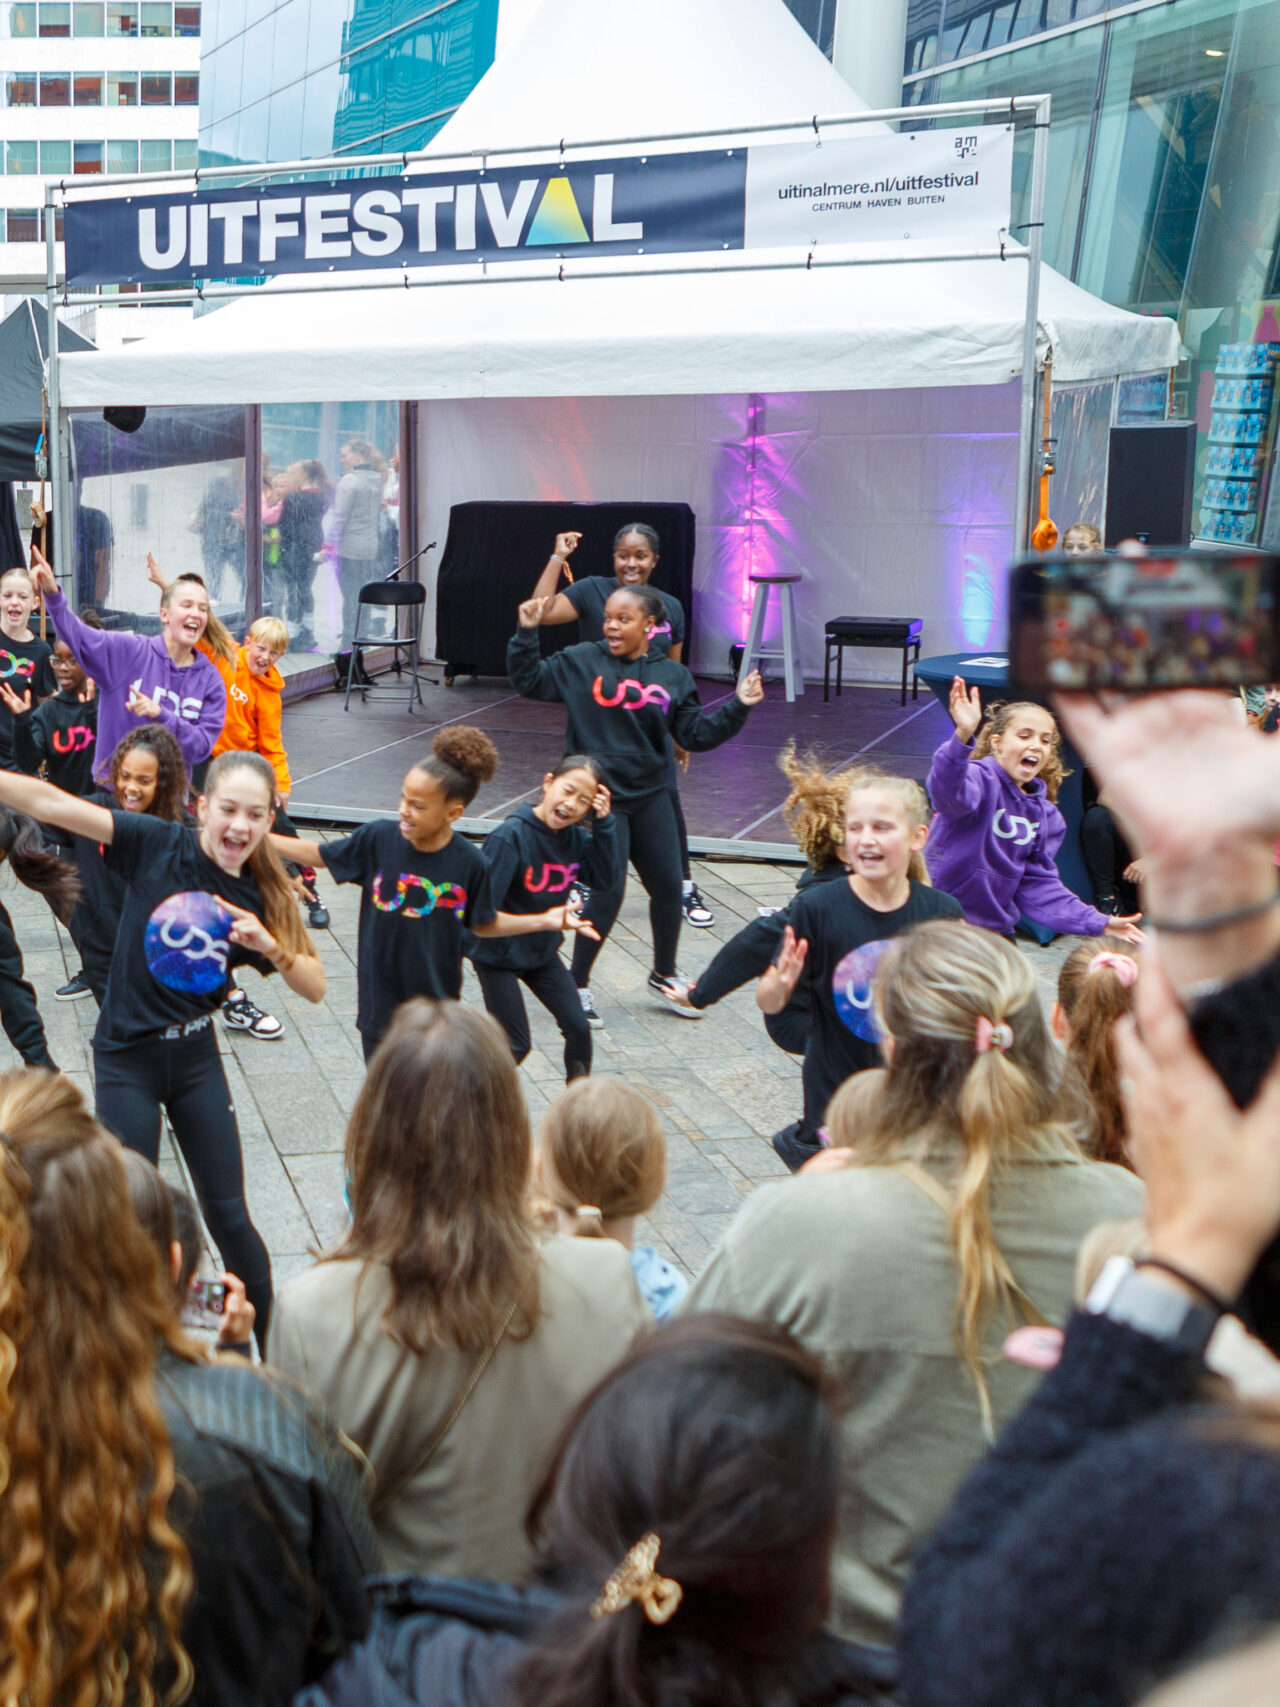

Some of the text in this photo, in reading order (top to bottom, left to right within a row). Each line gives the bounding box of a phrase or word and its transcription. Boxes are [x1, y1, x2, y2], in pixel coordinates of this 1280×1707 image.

[778, 171, 979, 200] uitinalmere.nl/uitfestival
[812, 195, 945, 212] CENTRUM HAVEN BUITEN
[138, 174, 644, 271] UITFESTIVAL
[593, 675, 671, 716] UDA
[372, 870, 468, 922] UDA
